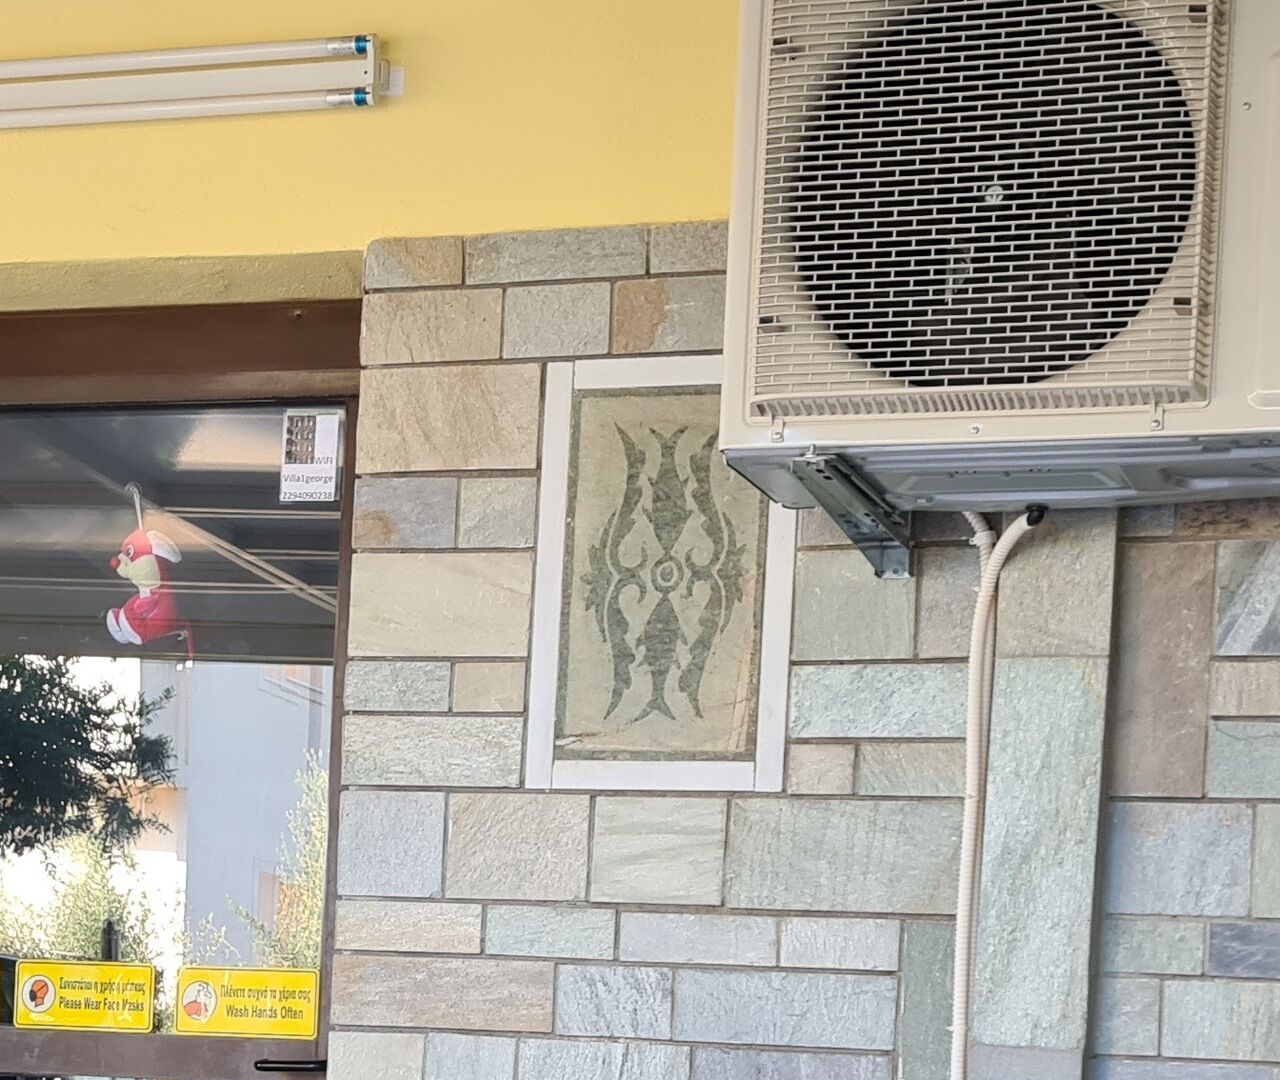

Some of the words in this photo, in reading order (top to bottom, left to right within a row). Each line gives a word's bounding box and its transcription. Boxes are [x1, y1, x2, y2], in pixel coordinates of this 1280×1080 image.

[59, 996, 82, 1010] Please
[84, 997, 102, 1010] Wear
[103, 998, 120, 1011] Face
[122, 998, 145, 1012] Masks
[226, 1005, 249, 1018] Wash
[251, 1005, 278, 1019] Hands
[281, 1006, 304, 1019] Often
